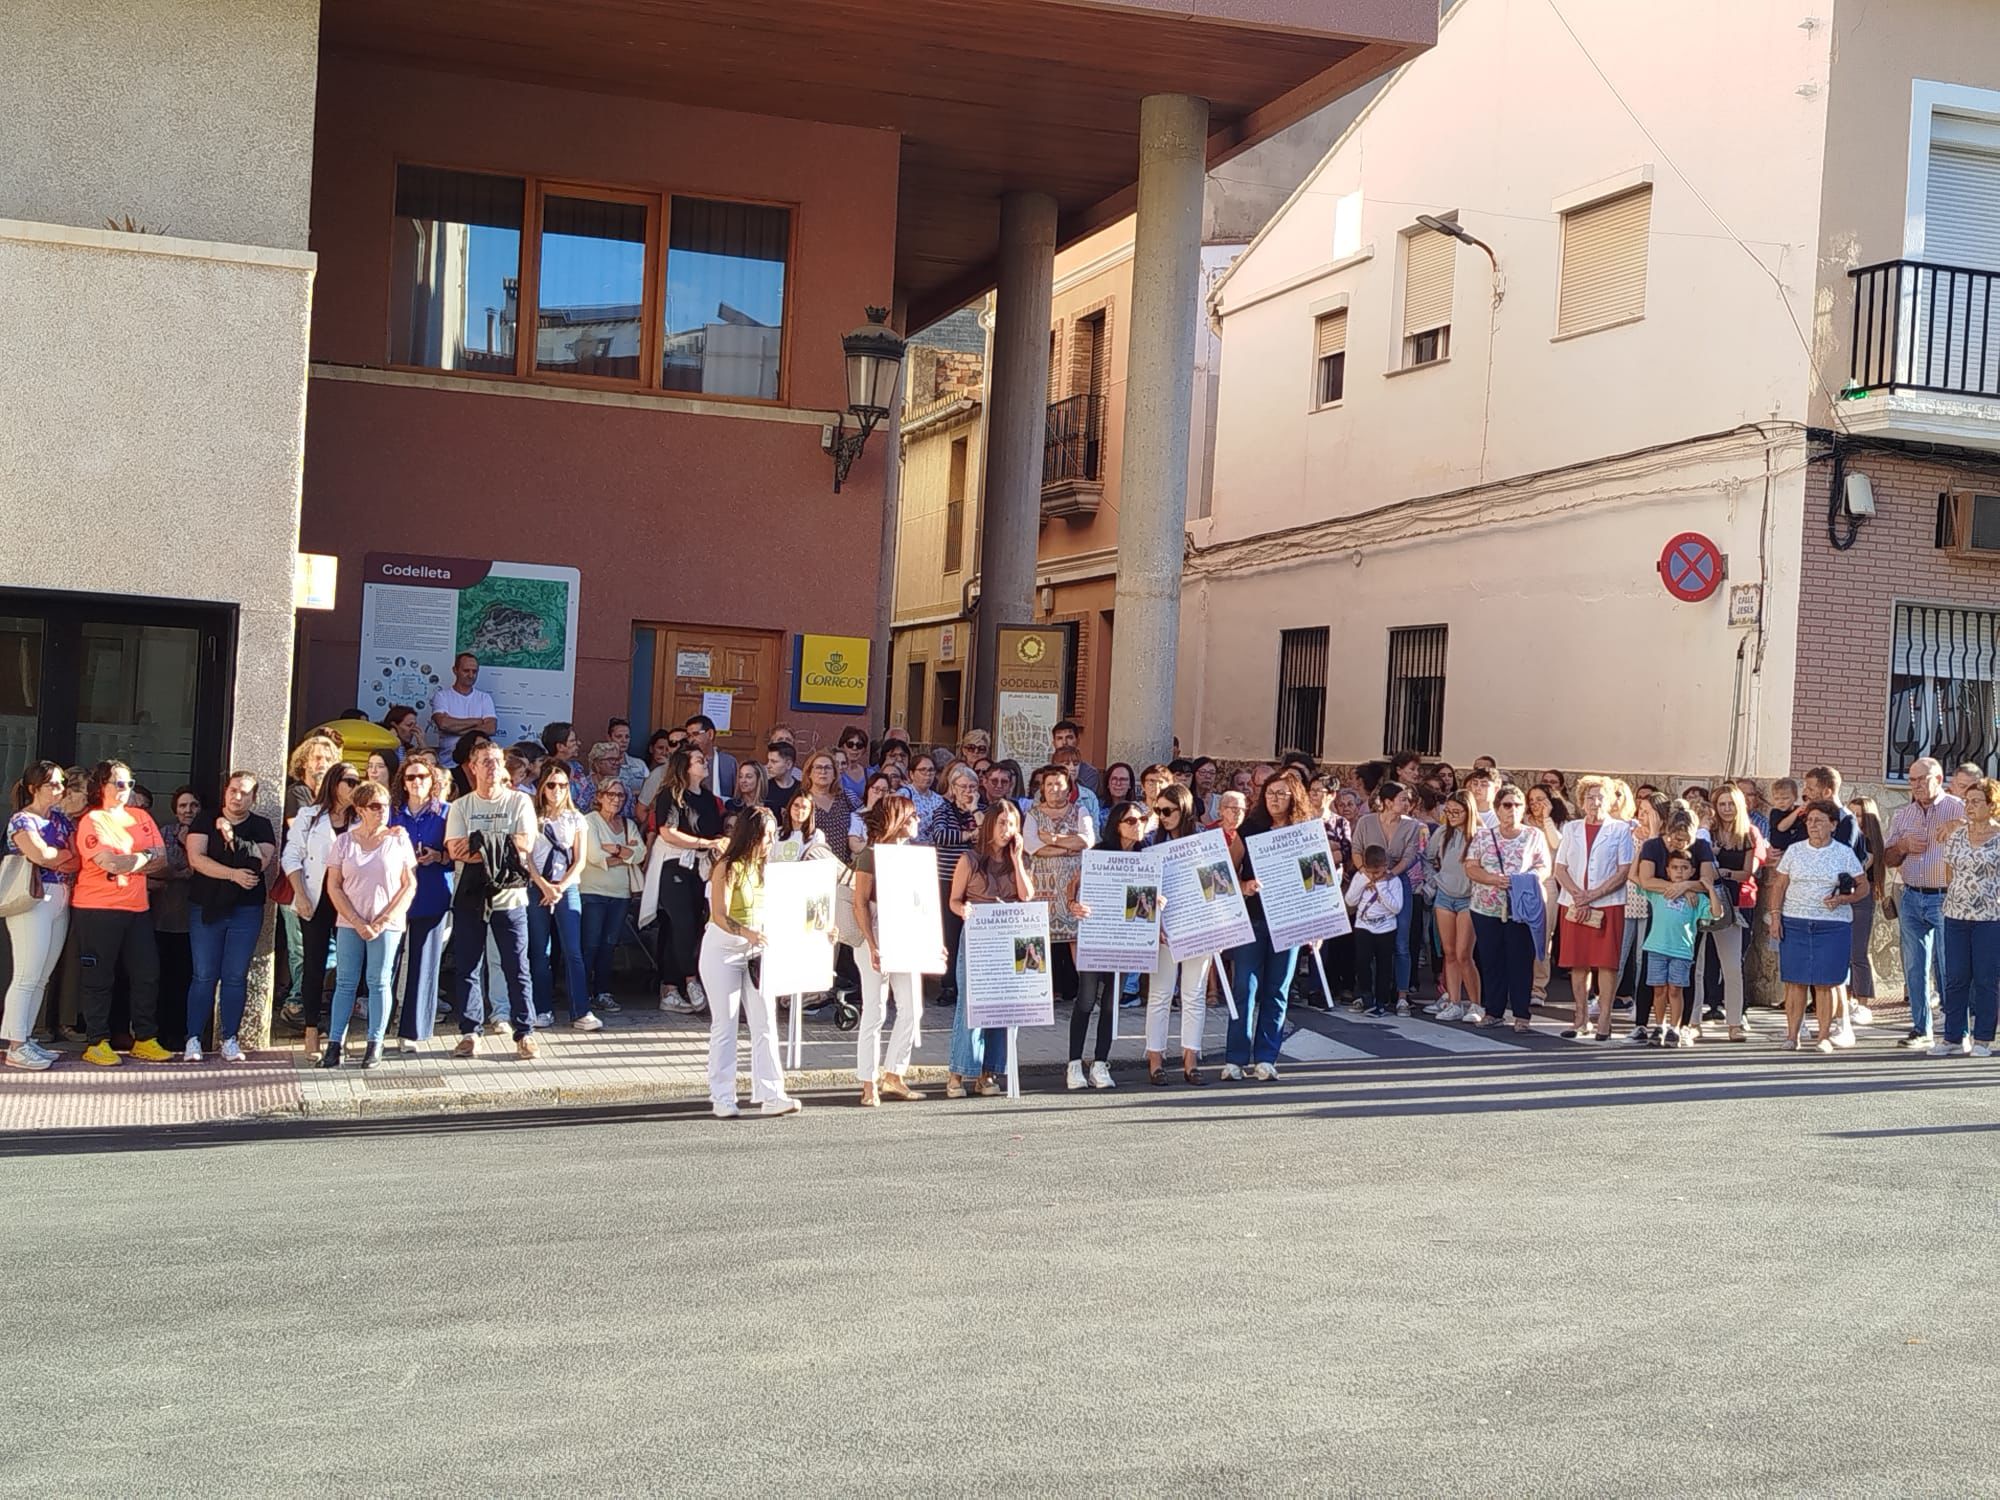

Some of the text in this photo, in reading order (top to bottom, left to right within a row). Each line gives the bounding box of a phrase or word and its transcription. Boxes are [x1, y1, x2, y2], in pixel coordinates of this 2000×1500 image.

[382, 563, 451, 580] Godelleta
[805, 672, 865, 689] CORREOS
[1000, 678, 1059, 689] GODELLETA
[1271, 830, 1303, 843] JUNTOS
[1168, 840, 1202, 853] JUNTOS
[1200, 843, 1219, 853] MÁS
[1258, 833, 1319, 854] SUMAMOS MÁS
[1107, 857, 1141, 865] JUNTOS
[1092, 864, 1155, 873] SUMAMOS MÁS
[991, 908, 1025, 917] JUNTOS
[975, 915, 1041, 925] SUMAMOS MÁS
